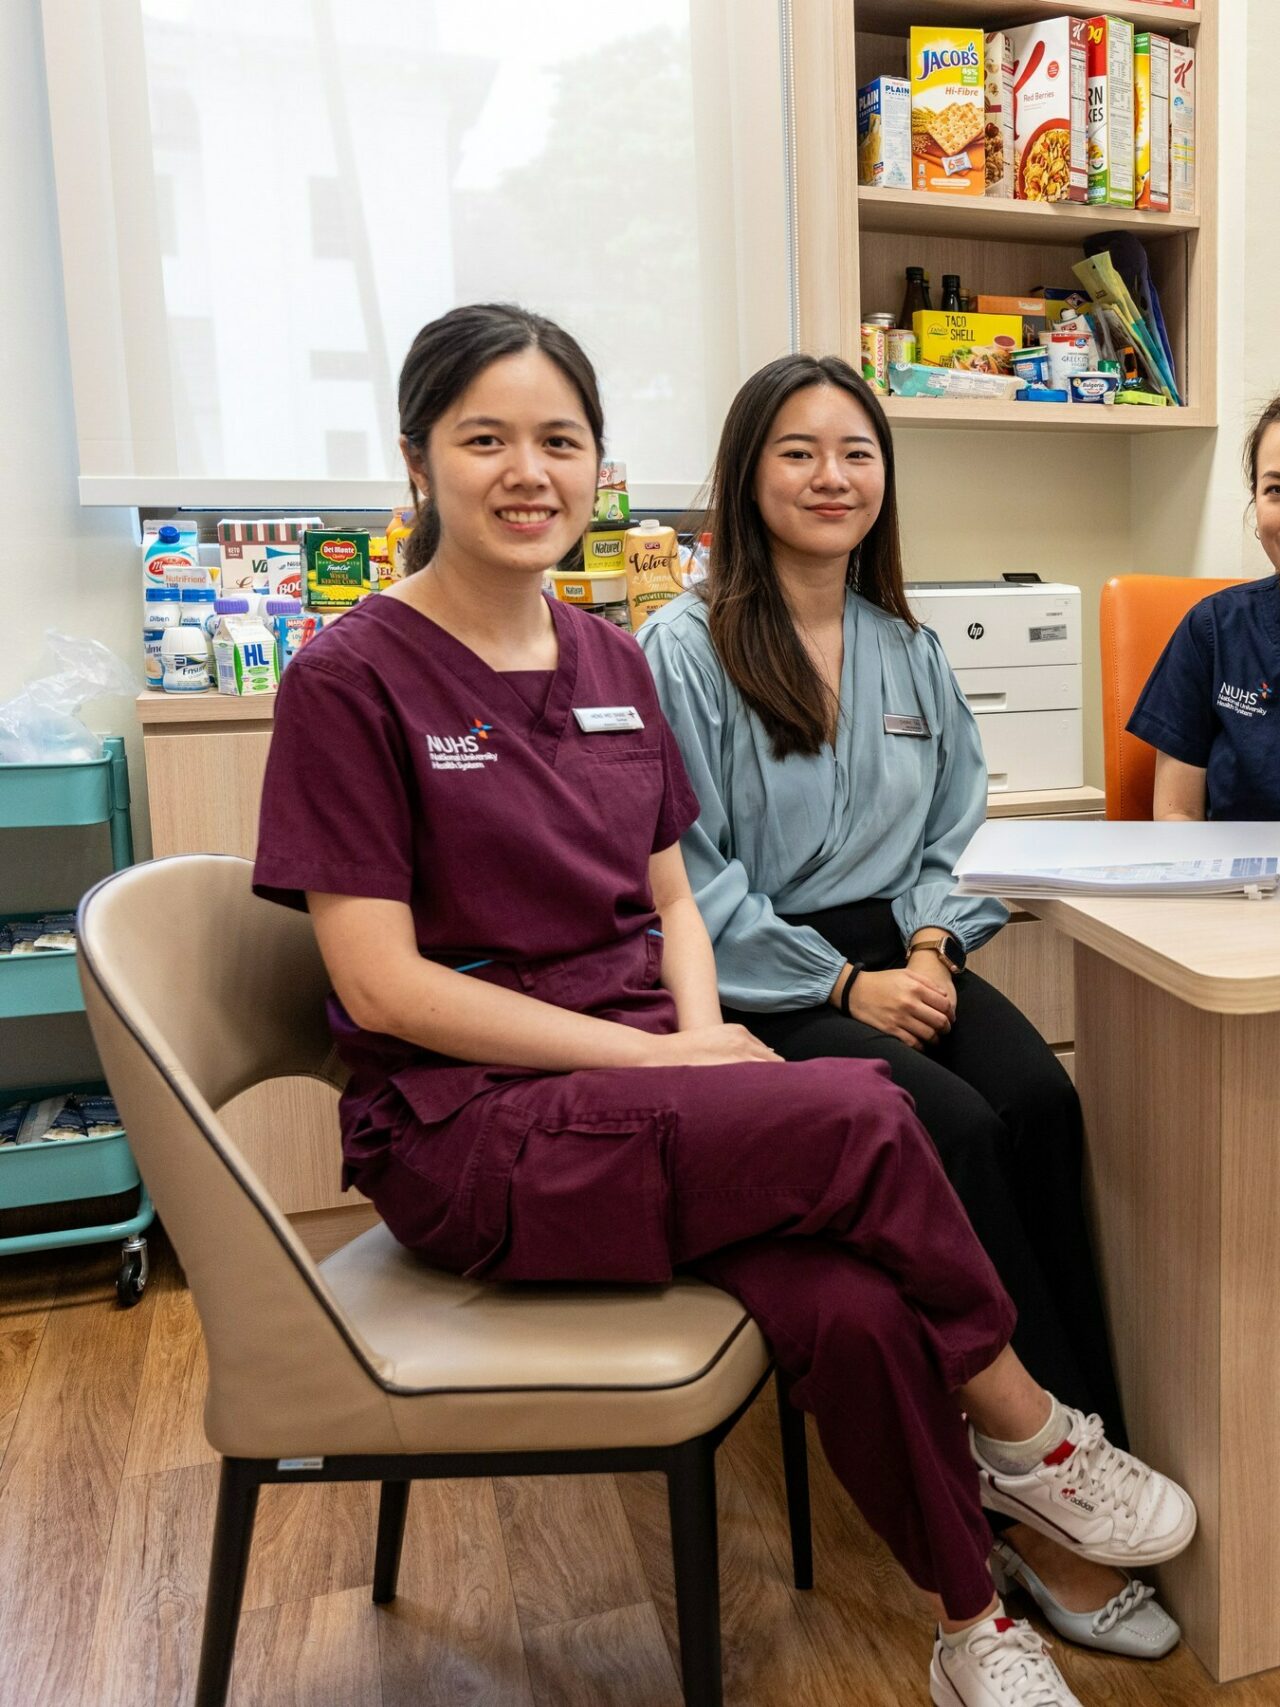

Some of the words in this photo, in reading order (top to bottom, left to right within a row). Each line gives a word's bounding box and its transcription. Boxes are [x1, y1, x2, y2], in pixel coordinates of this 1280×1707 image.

[1073, 23, 1086, 40] K
[915, 43, 979, 80] JACOB'S
[1174, 59, 1193, 88] K
[885, 85, 910, 94] PLAIN
[945, 86, 979, 97] Hi-Fibre
[1023, 93, 1034, 102] Red
[1035, 90, 1055, 100] Berries
[860, 89, 879, 111] PLAIN
[945, 315, 967, 328] TACO
[950, 328, 976, 342] SHELL
[335, 546, 355, 554] Monte
[595, 542, 620, 554] Naturel
[629, 552, 678, 573] Velve
[970, 623, 983, 639] hp
[243, 643, 270, 667] HL
[1220, 682, 1258, 705] NUHS
[1217, 699, 1234, 710] Health
[1218, 693, 1240, 706] National
[1240, 703, 1267, 716] University
[426, 734, 479, 753] NUHS
[1071, 1497, 1094, 1512] adidas
